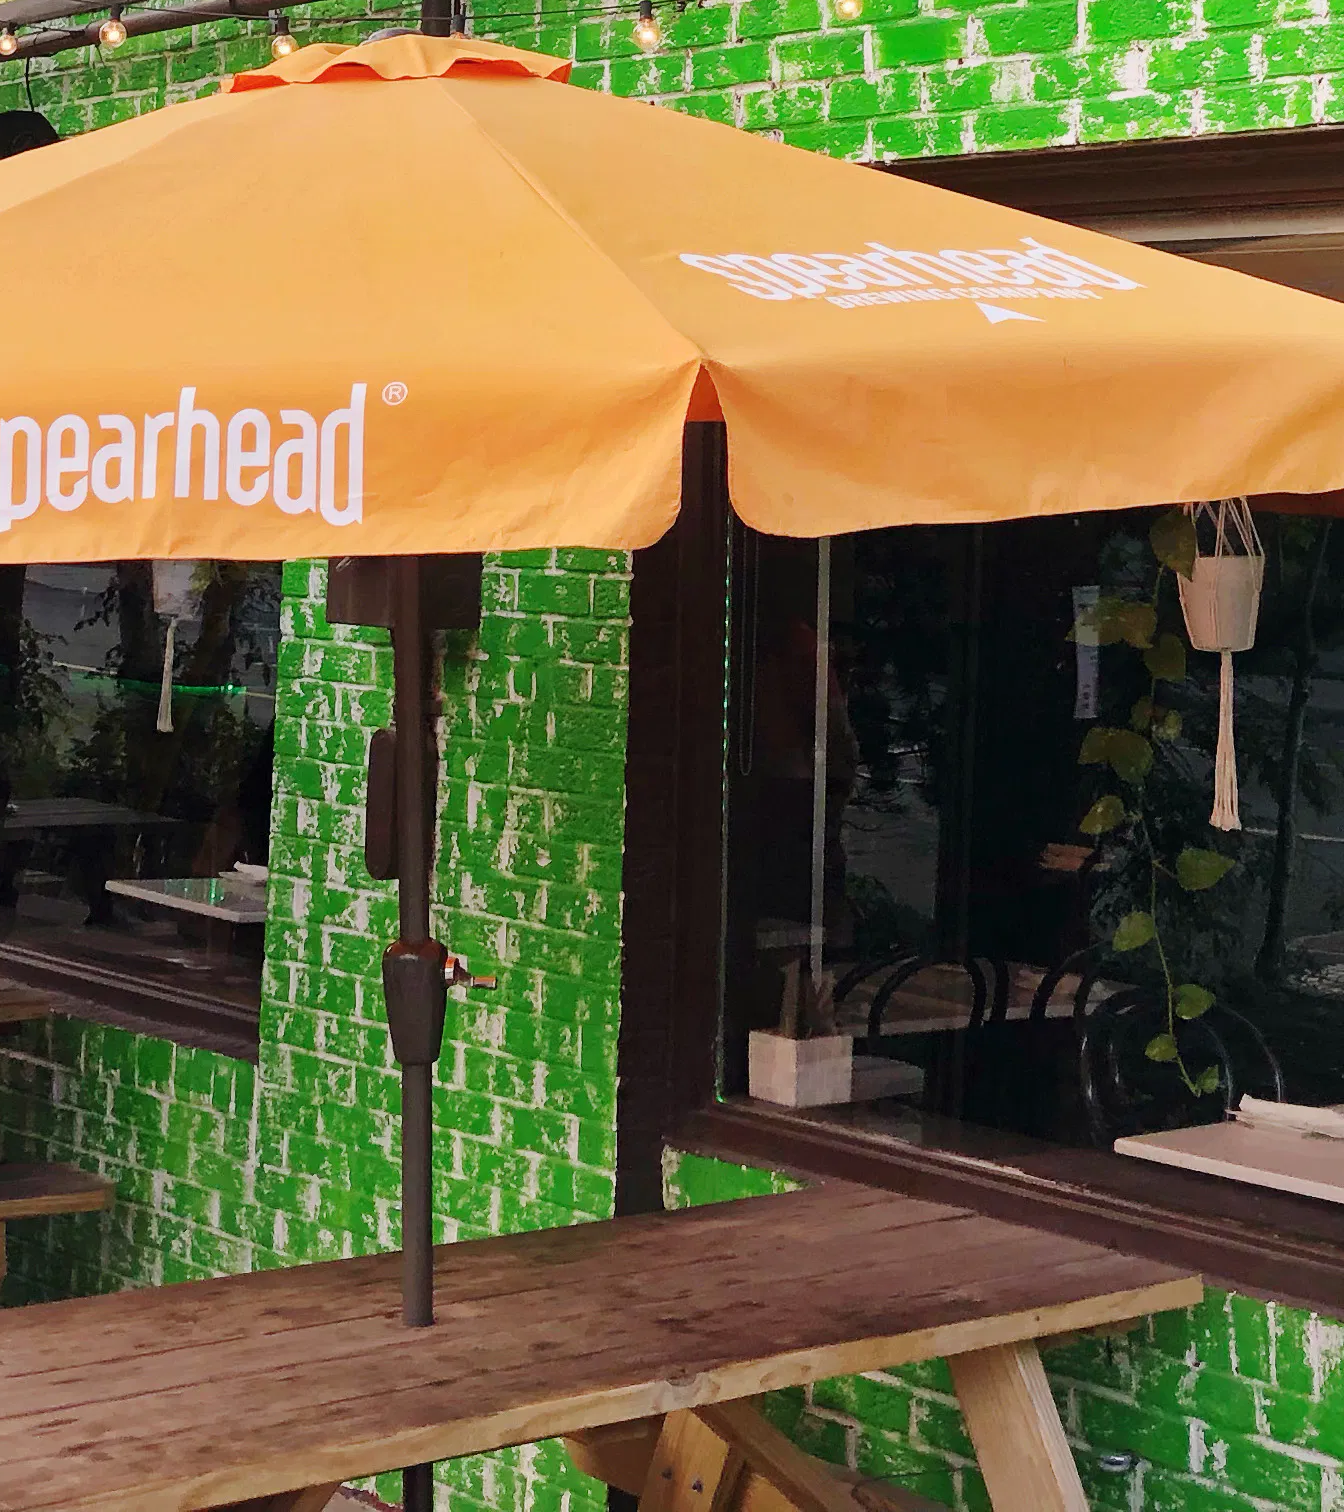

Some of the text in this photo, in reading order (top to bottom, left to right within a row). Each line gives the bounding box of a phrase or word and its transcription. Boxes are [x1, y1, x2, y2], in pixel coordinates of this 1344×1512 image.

[679, 236, 1147, 300] spearhead
[822, 286, 1104, 309] BREWING COMPANY
